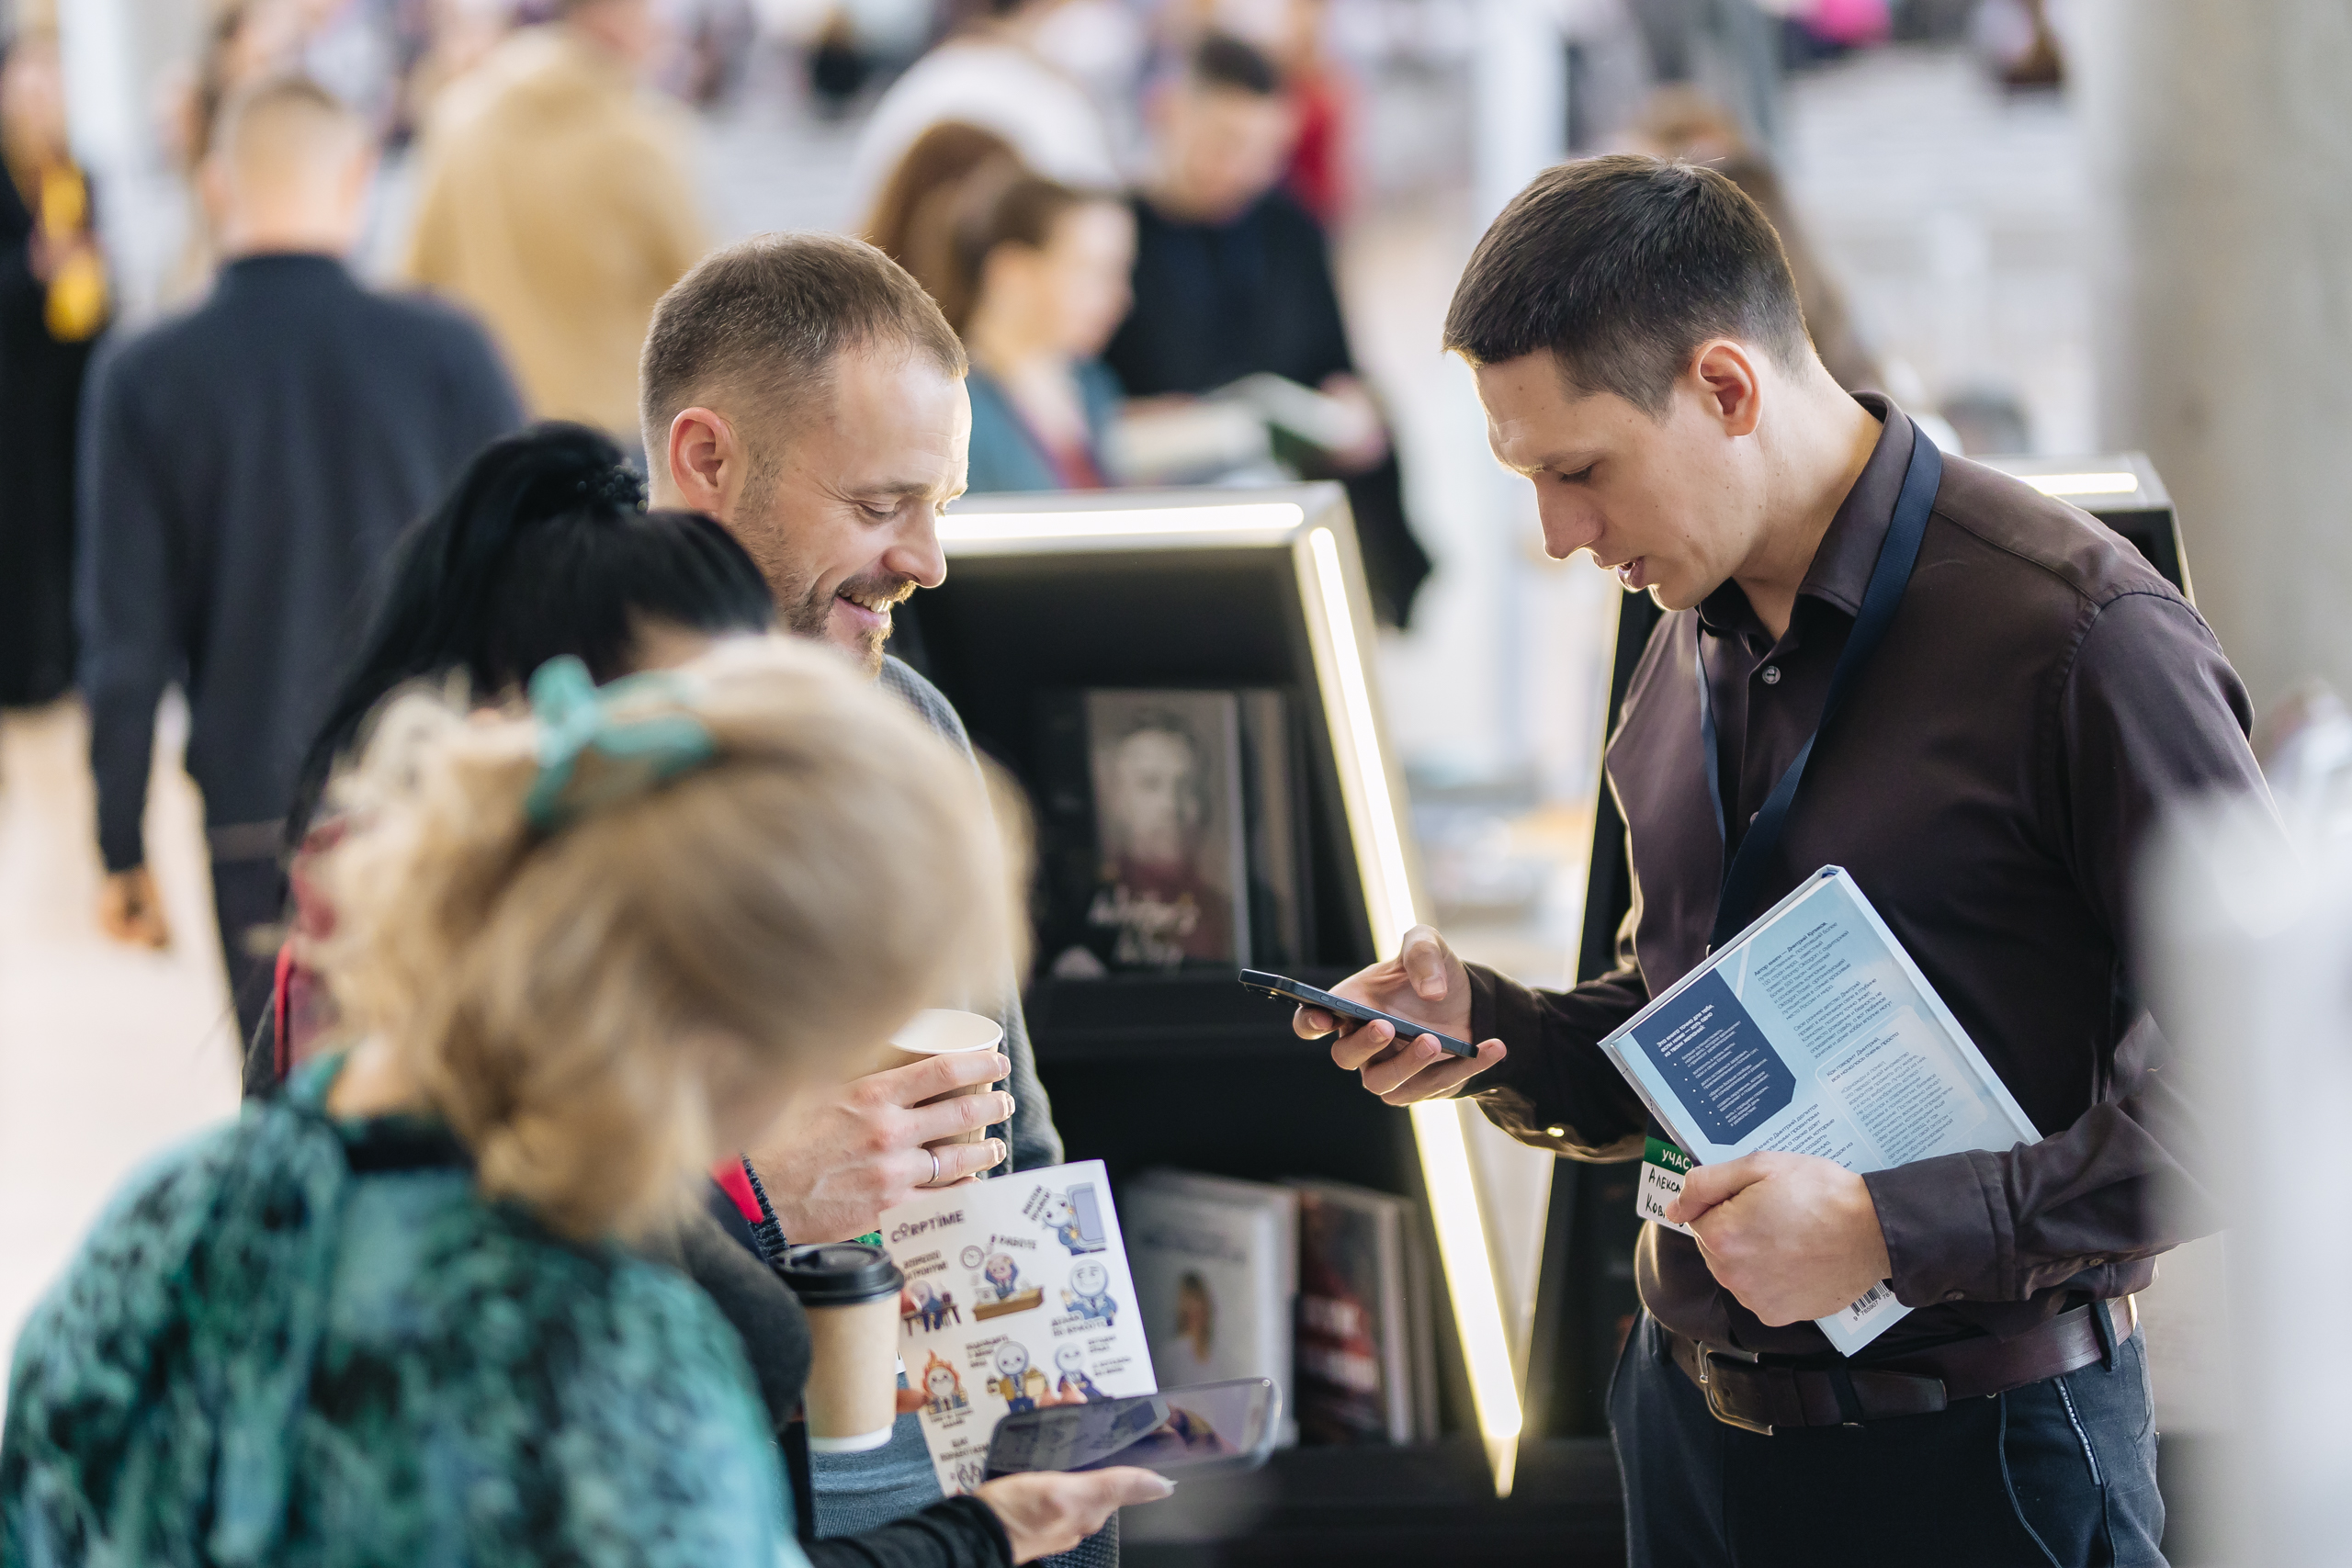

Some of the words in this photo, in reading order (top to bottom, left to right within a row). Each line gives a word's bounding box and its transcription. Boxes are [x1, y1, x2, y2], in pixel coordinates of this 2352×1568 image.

[1837, 1054, 1857, 1070] говорит
[1841, 1056, 1865, 1076] началось
[1773, 1120, 1797, 1139] Дмитрий
[1797, 1104, 1818, 1122] делится
[1662, 1149, 1693, 1170] УЧАС
[1648, 1167, 1681, 1194] АЛЕКСА
[1860, 1300, 1879, 1315] 785907
